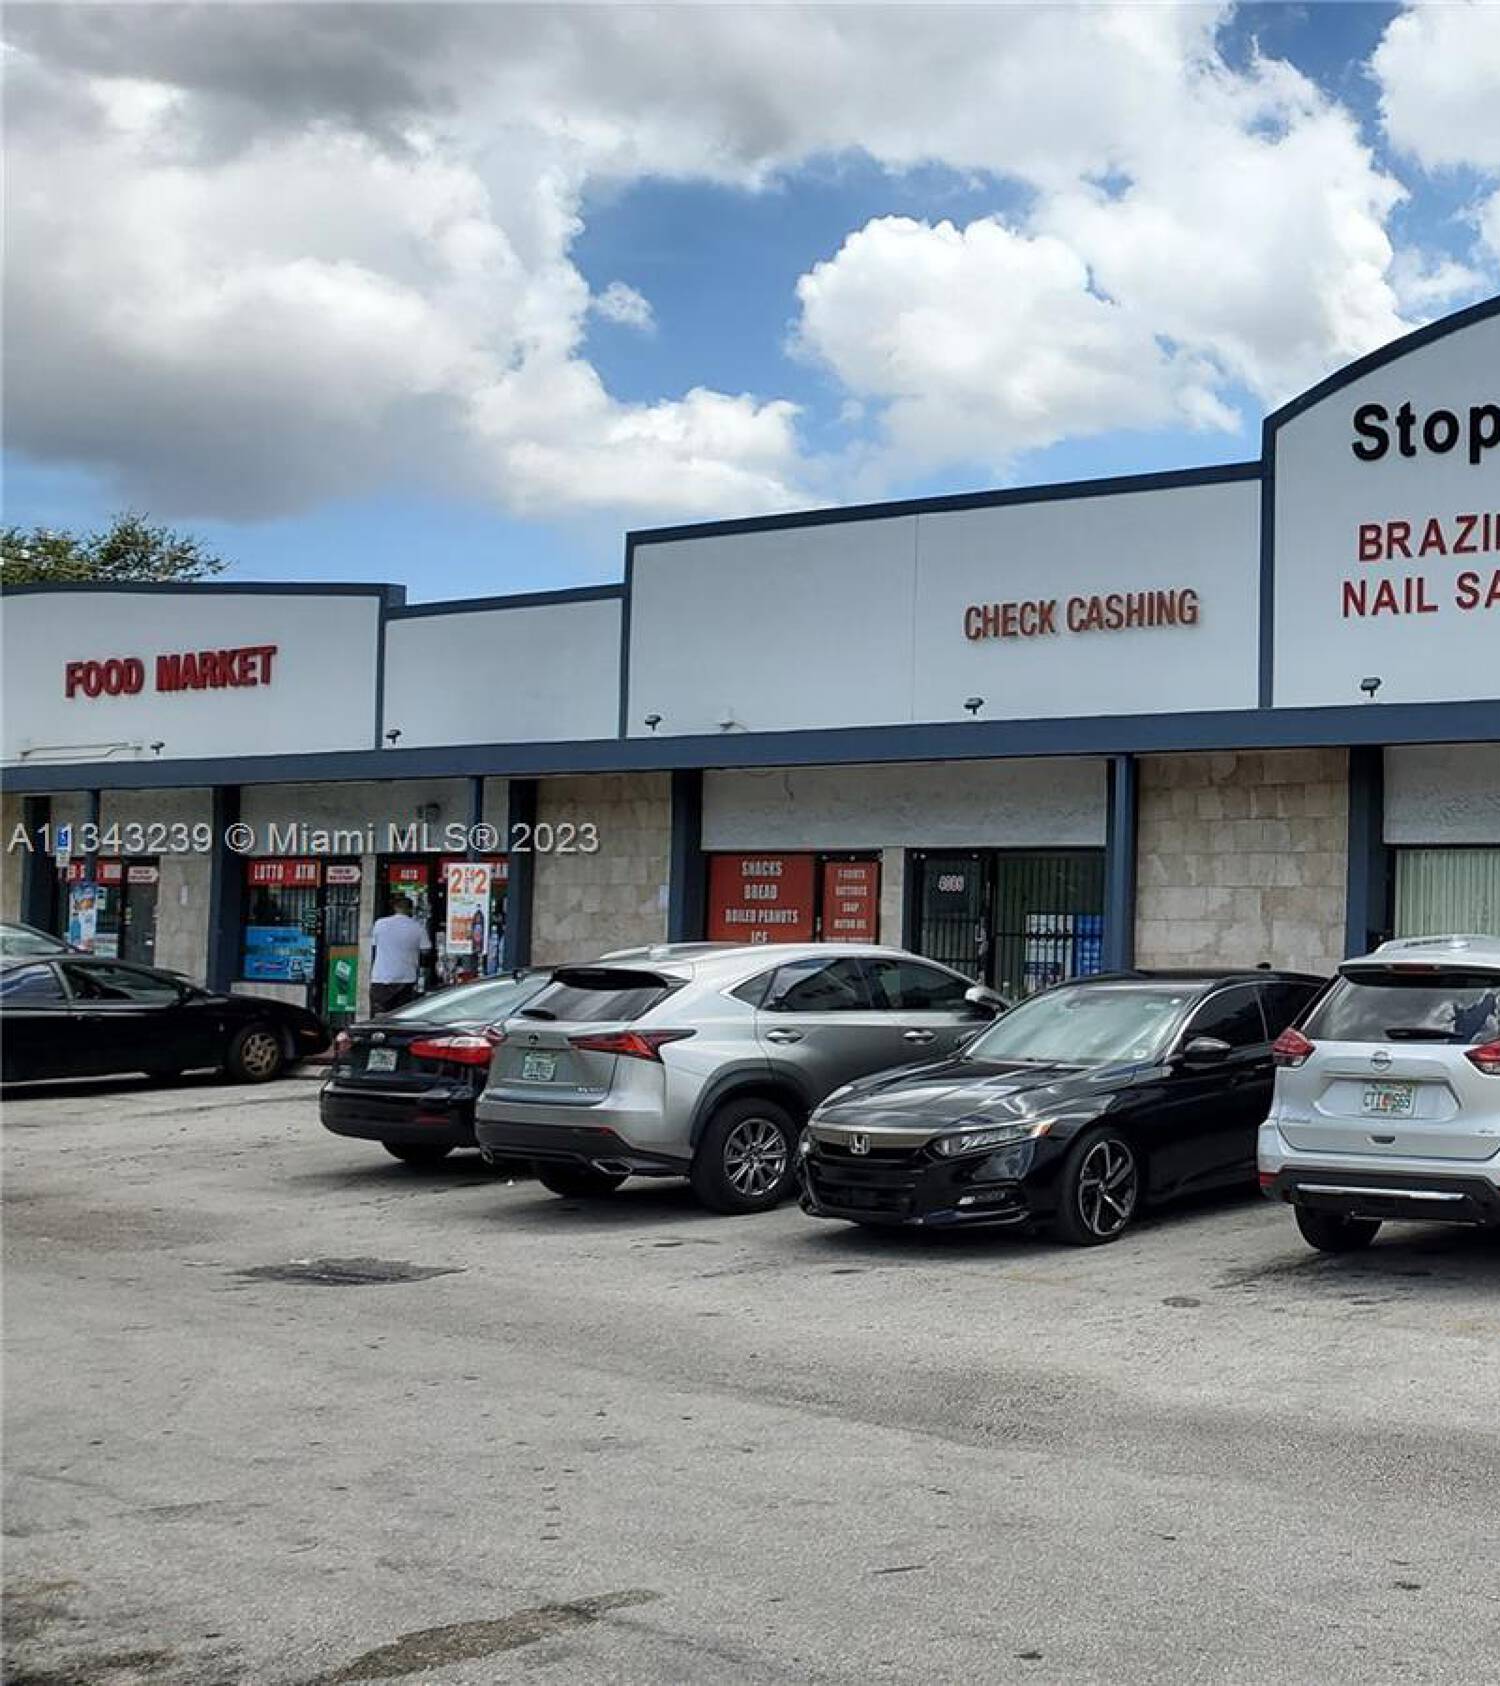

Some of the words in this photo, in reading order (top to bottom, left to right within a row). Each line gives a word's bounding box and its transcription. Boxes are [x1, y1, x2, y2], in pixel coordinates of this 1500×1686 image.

[1342, 574, 1439, 618] NAIL
[963, 599, 1057, 641] CHECK
[1066, 587, 1199, 633] CASHING
[65, 657, 146, 699] FOOD
[155, 644, 278, 693] MARKET
[741, 860, 782, 877] SNACKS
[743, 884, 778, 900] BREAD
[724, 908, 757, 924] BOILED
[758, 908, 799, 924] PEANUTS
